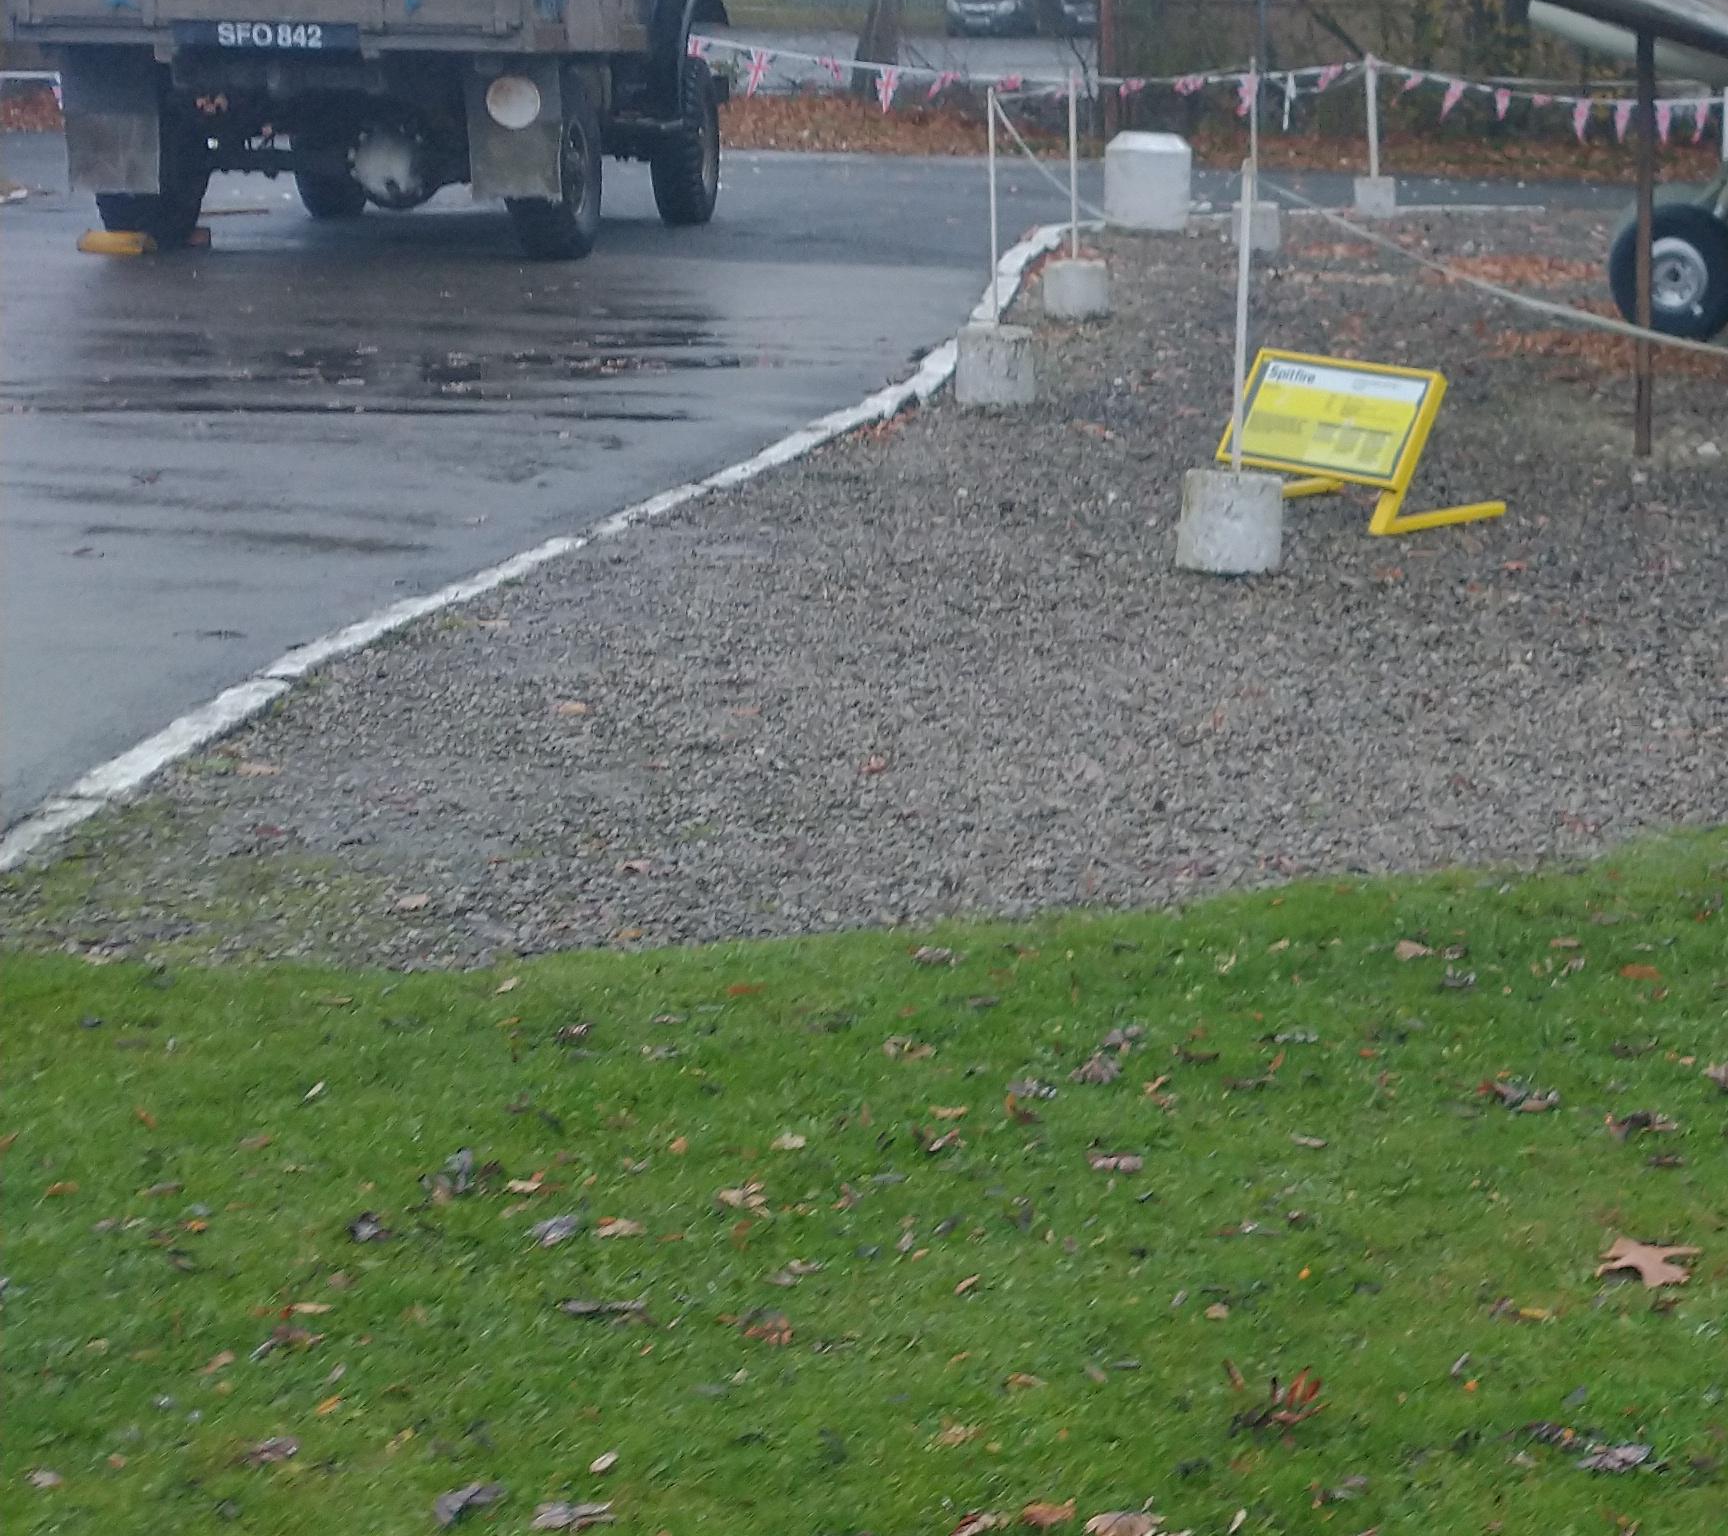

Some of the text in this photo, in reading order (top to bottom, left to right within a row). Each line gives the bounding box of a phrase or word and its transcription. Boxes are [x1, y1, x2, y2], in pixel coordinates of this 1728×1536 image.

[217, 21, 323, 49] SFO 842
[1270, 365, 1316, 384] Spitfire
